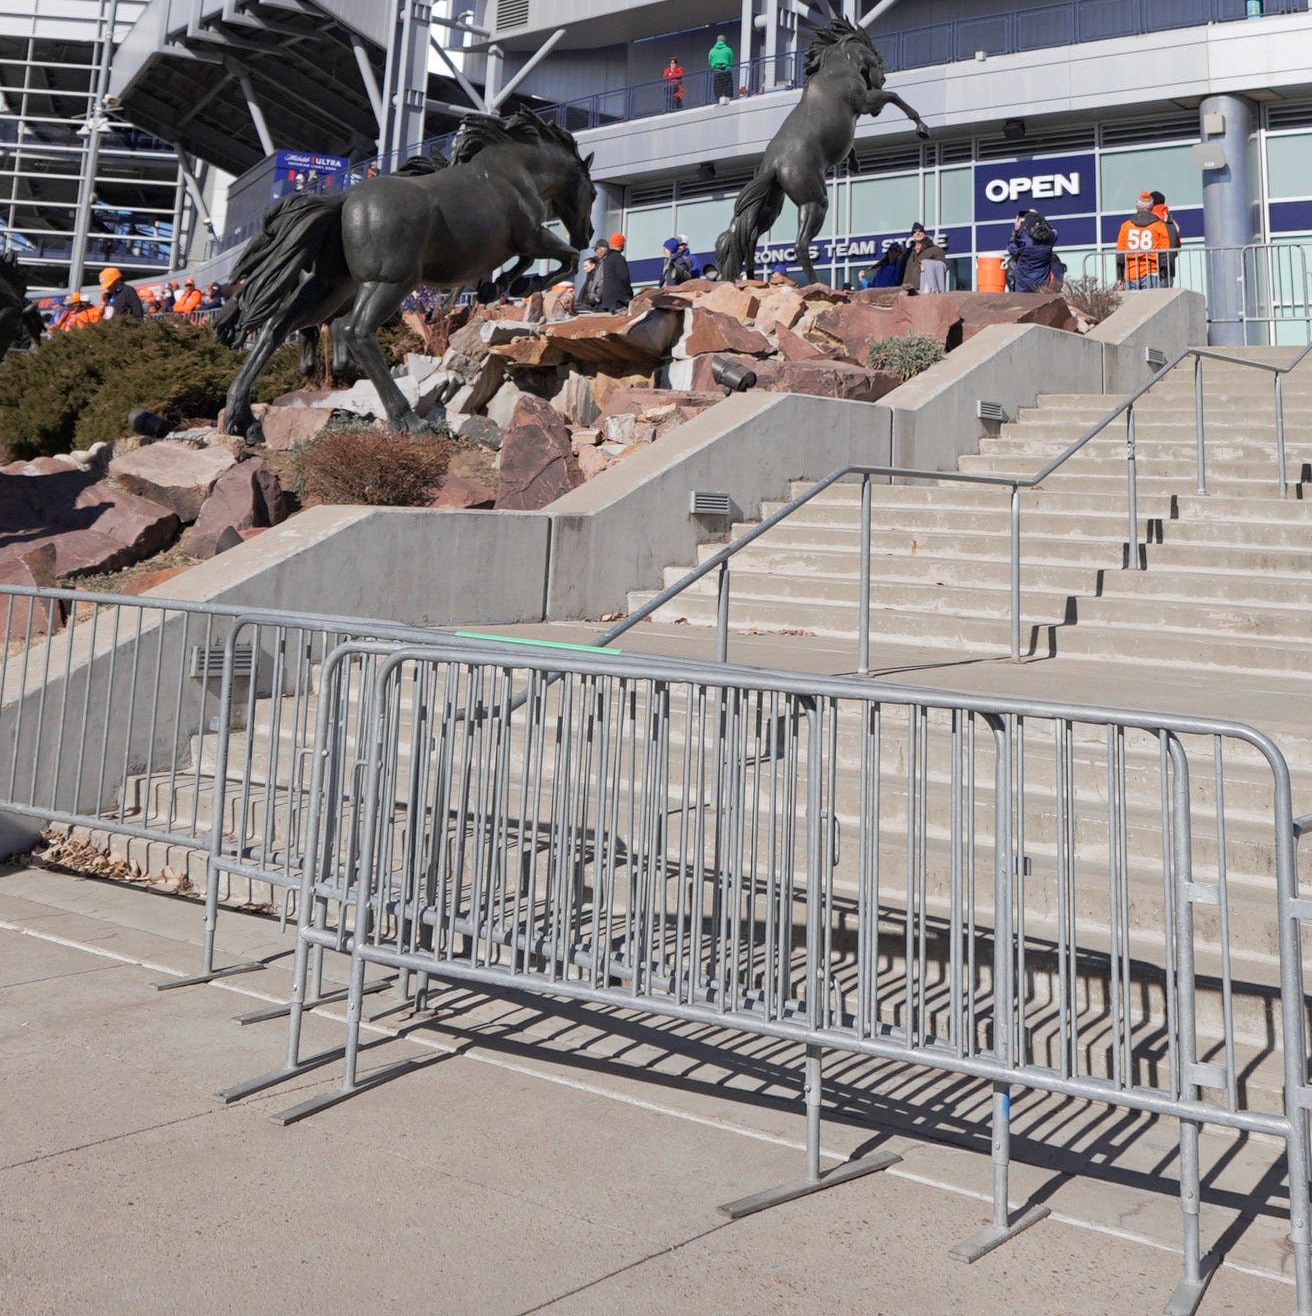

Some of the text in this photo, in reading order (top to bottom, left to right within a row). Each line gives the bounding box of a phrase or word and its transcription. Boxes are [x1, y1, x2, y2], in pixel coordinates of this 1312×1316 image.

[316, 157, 341, 167] ULTRA
[985, 172, 1080, 203] OPEN
[1128, 229, 1153, 250] 58
[824, 241, 875, 257] TEAM
